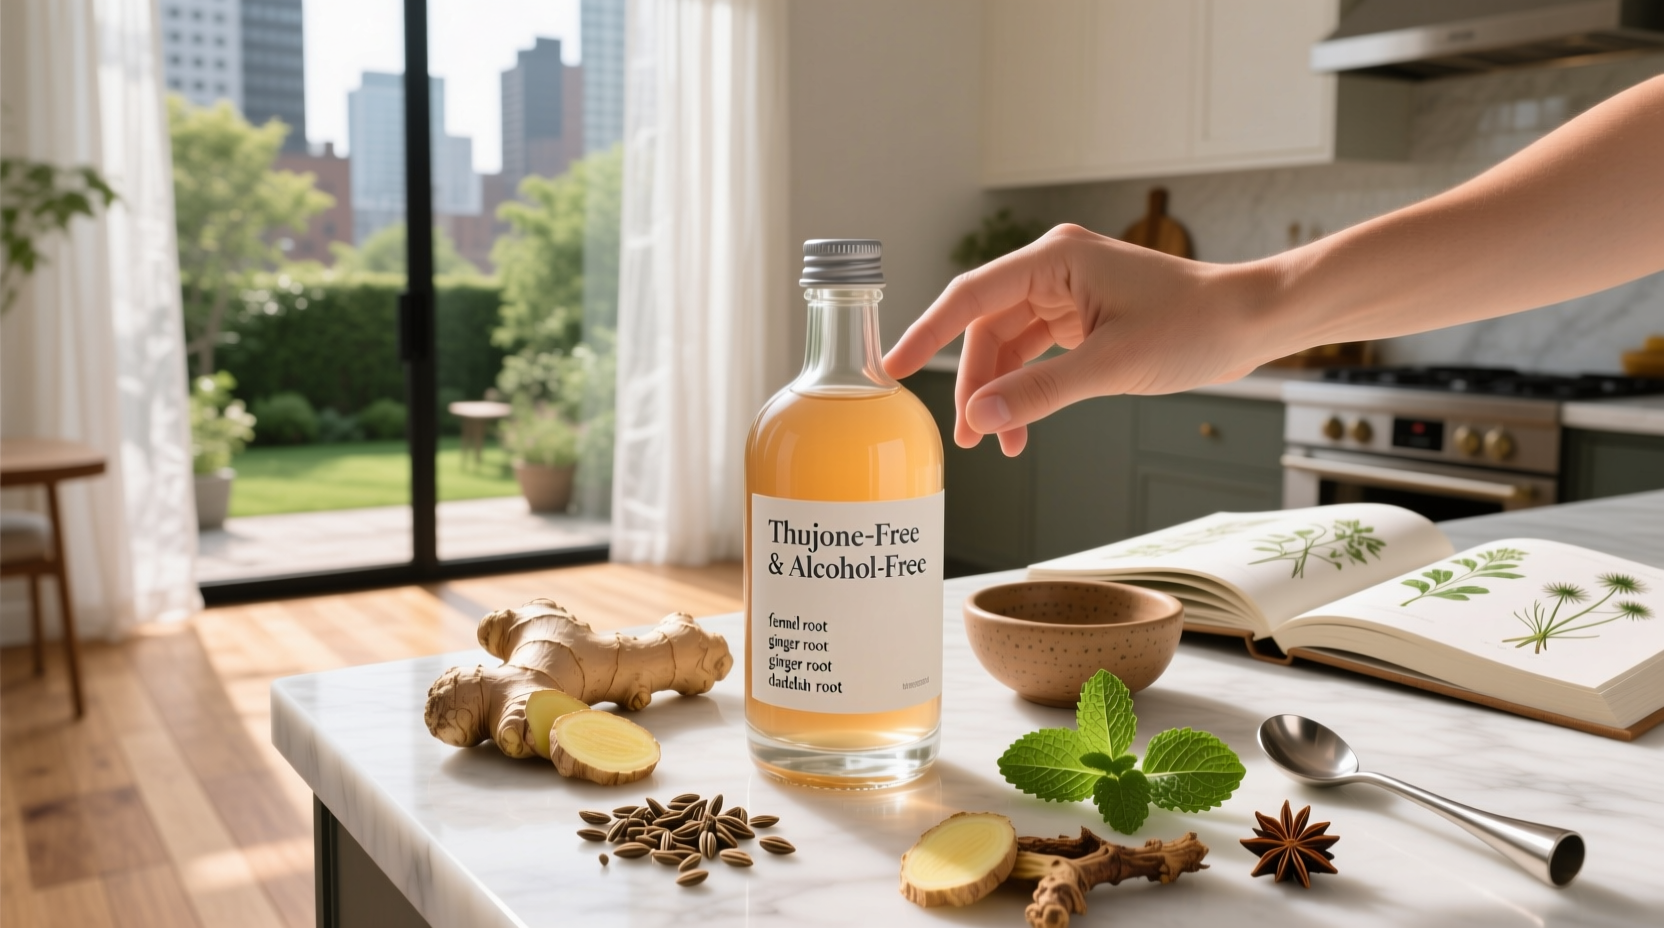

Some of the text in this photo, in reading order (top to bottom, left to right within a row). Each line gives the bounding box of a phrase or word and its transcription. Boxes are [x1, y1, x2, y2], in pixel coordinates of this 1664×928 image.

[768, 519, 920, 553] Thujone-Free
[768, 552, 927, 579] & Alcohol-Free
[803, 621, 828, 632] root
[768, 634, 829, 652] ginger root
[768, 654, 832, 673] ginger root
[816, 681, 843, 693] root
